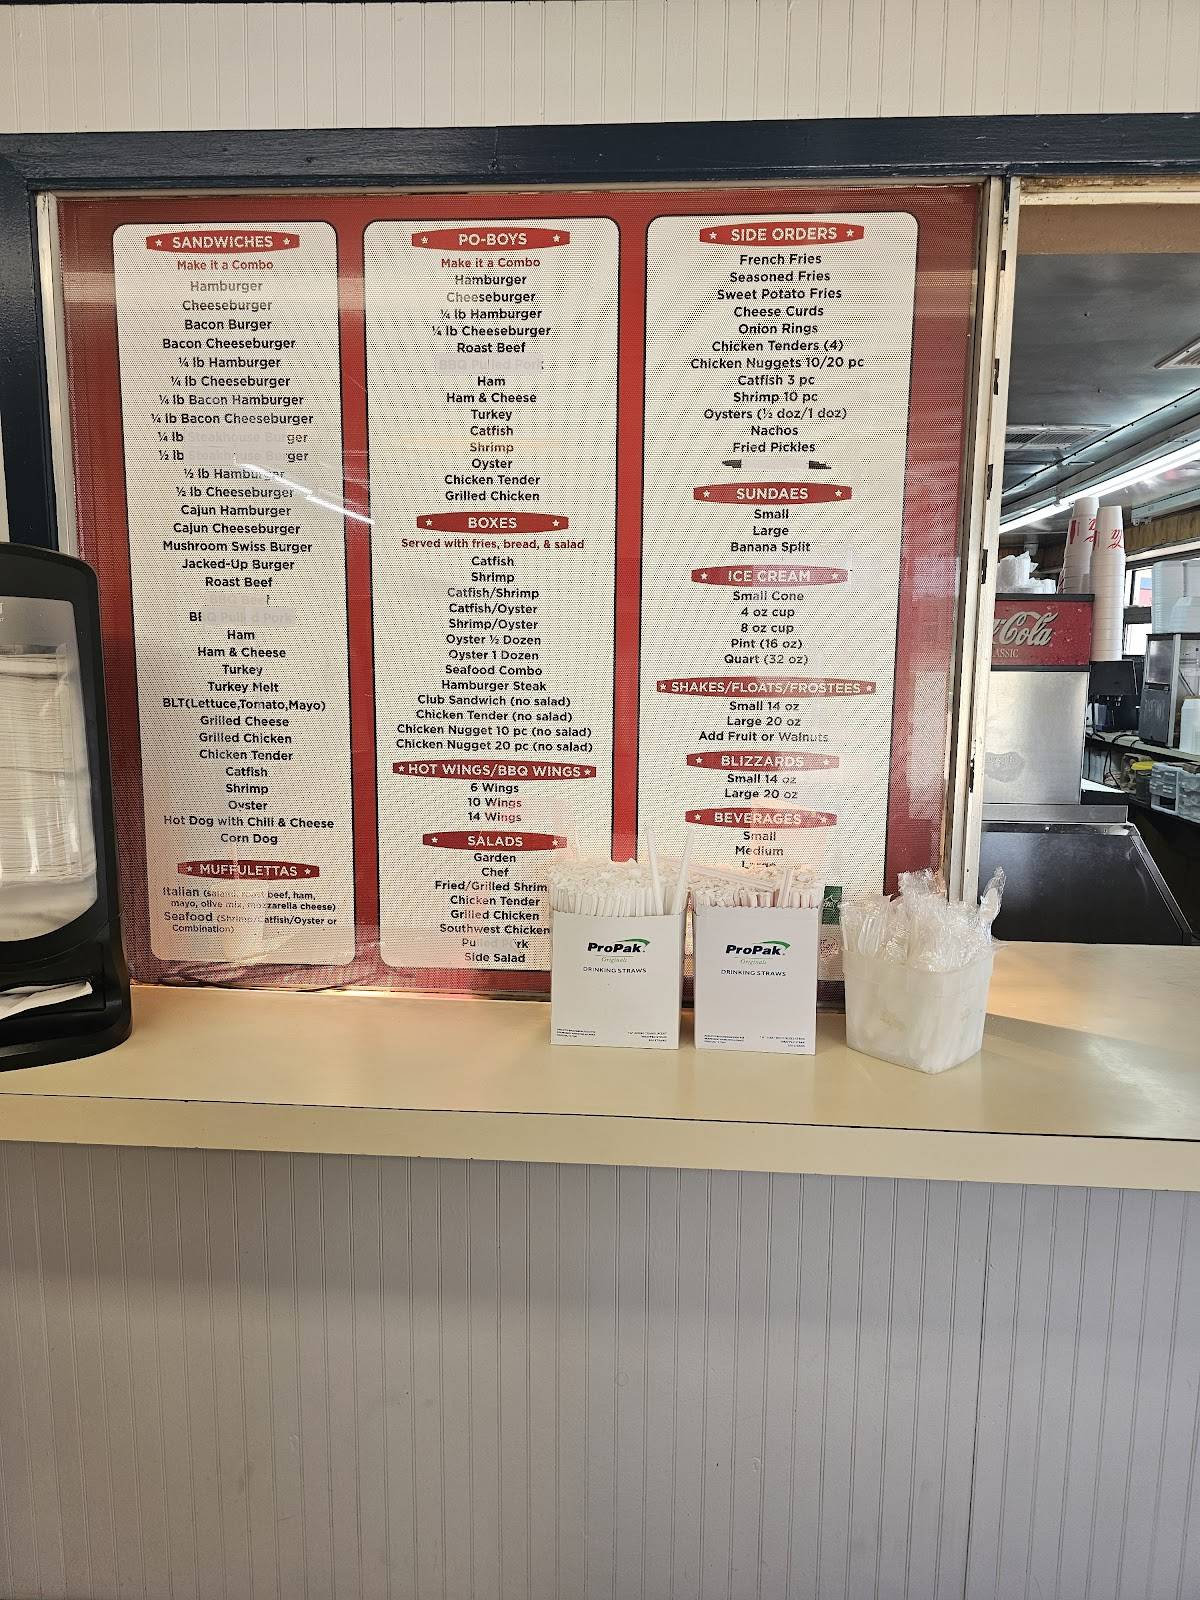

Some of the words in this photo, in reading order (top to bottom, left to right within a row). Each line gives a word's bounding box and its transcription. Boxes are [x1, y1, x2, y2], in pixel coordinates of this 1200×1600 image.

[459, 233, 528, 245] PO-BOYS
[730, 228, 766, 241] SIDE
[772, 227, 837, 240] ORDERS
[173, 236, 274, 248] SANDWICHES
[441, 259, 471, 267] Make
[475, 258, 483, 267] it
[487, 260, 494, 268] a
[497, 258, 540, 267] Combo
[740, 255, 785, 265] French
[789, 254, 822, 264] Fries
[455, 275, 527, 286] Hamburger
[730, 272, 794, 282] Seasoned
[798, 271, 830, 281] Fries
[717, 290, 757, 299] Sweet
[761, 289, 805, 299] Potato
[810, 288, 842, 298] Fries
[183, 301, 272, 311] Cheeseburger
[734, 307, 781, 317] Cheese
[786, 306, 824, 316] Curds
[185, 320, 224, 330] Bacon
[228, 319, 272, 331] Burger
[739, 324, 777, 334] Onion
[782, 323, 818, 335] Rings
[163, 339, 202, 349] Bacon
[206, 339, 296, 349] Cheeseburger
[171, 376, 181, 386] ¼
[185, 376, 197, 386] lb
[201, 376, 291, 387] Cheeseburger
[478, 377, 506, 386] Ham
[738, 375, 783, 385] Catfish
[788, 375, 795, 385] 3
[799, 377, 815, 386] pc
[471, 409, 512, 420] Turkey
[470, 426, 513, 436] Catfish
[751, 426, 798, 435] Nachos
[470, 444, 514, 452] Shrimp
[733, 442, 766, 452] Fried
[770, 442, 816, 452] Pickles
[472, 459, 513, 469] Oyster
[445, 475, 493, 484] Chicken
[498, 475, 540, 485] Tender
[446, 491, 486, 500] Grilled
[490, 491, 540, 501] Chicken
[737, 488, 809, 499] SUNDAES
[181, 504, 216, 516] Cajun
[220, 506, 291, 517] Hamburger
[754, 509, 789, 519] Small
[468, 517, 518, 528] BOXES
[174, 522, 208, 533] Cajun
[212, 524, 300, 534] Cheeseburger
[753, 526, 789, 537] Large
[163, 541, 228, 551] Mushroom
[232, 542, 266, 551] Swiss
[270, 542, 312, 553] Burger
[401, 539, 441, 547] Served
[444, 539, 468, 548] with
[472, 539, 499, 548] fries,
[503, 540, 539, 548] bread,
[543, 540, 550, 549] &
[555, 540, 585, 549] salad
[730, 542, 777, 552] Banana
[781, 542, 811, 552] Split
[182, 559, 248, 569] Jacked-Up
[252, 560, 295, 571] Burger
[471, 556, 514, 566] Catfish
[471, 572, 515, 582] Shrimp
[729, 571, 751, 581] ICE
[757, 570, 811, 582] CREAM
[205, 577, 240, 587] Roast
[244, 577, 273, 587] Beef
[447, 588, 540, 598] Catfish/Shrimp
[733, 591, 767, 600] Small
[771, 592, 804, 601] Cone
[449, 603, 537, 613] Catfish/Oyster
[741, 623, 748, 633] 8
[752, 625, 766, 633] oz
[771, 625, 794, 633] cup
[228, 631, 255, 639] Ham
[198, 647, 225, 656] Ham
[229, 647, 237, 657] &
[241, 648, 286, 657] Cheese
[449, 650, 488, 660] Oyster
[492, 650, 497, 659] 1
[501, 651, 539, 660] Dozen
[222, 664, 263, 674] Turkey
[445, 665, 495, 674] Seafood
[499, 666, 542, 675] Combo
[208, 681, 248, 692] Turkey
[252, 683, 279, 692] Melt
[442, 680, 508, 691] Hamburger
[513, 681, 546, 691] Steak
[671, 681, 861, 693] SHAKES/FLOATS/FROSTEES
[418, 695, 445, 704] Club
[449, 696, 506, 705] Sandwich
[510, 697, 530, 706] (no
[534, 697, 571, 706] salad)
[201, 715, 241, 725] Grilled
[245, 717, 289, 726] Cheese
[727, 717, 762, 727] Large
[766, 716, 782, 726] 20
[199, 732, 240, 742] Grilled
[243, 734, 292, 743] Chicken
[199, 749, 247, 759] Chicken
[252, 751, 293, 760] Tender
[721, 756, 805, 767] BLIZZARDS
[226, 767, 268, 776] Catfish
[408, 765, 437, 775] HOT
[442, 764, 528, 777] WINGS/BBQ
[533, 765, 581, 777] WINGS
[226, 784, 269, 793] Shrimp
[471, 783, 478, 792] 6
[482, 783, 519, 794] Wings
[725, 789, 759, 799] Large
[764, 789, 780, 798] 20
[229, 801, 268, 810] Oyster
[714, 813, 801, 824] BEVERAGES
[221, 833, 249, 842] Corn
[253, 834, 278, 845] Dog
[743, 831, 776, 840] Small
[468, 836, 523, 846] SALADS
[474, 853, 516, 862] Garden
[481, 868, 509, 876] Chef
[435, 880, 510, 891] Fried/Grilled
[513, 881, 548, 892] Shrim
[162, 886, 200, 897] Italian
[267, 891, 291, 900] beef,
[170, 899, 198, 909] mayo,
[200, 900, 223, 908] olive
[300, 903, 336, 911] cheese)
[164, 911, 213, 922] Seafood
[451, 910, 490, 919] Grilled
[493, 911, 539, 920] Chicken
[172, 924, 235, 934] Combination)
[440, 924, 500, 933] Southwest
[504, 925, 550, 934] Chicken
[465, 953, 489, 961] Side
[494, 954, 526, 962] Salad
